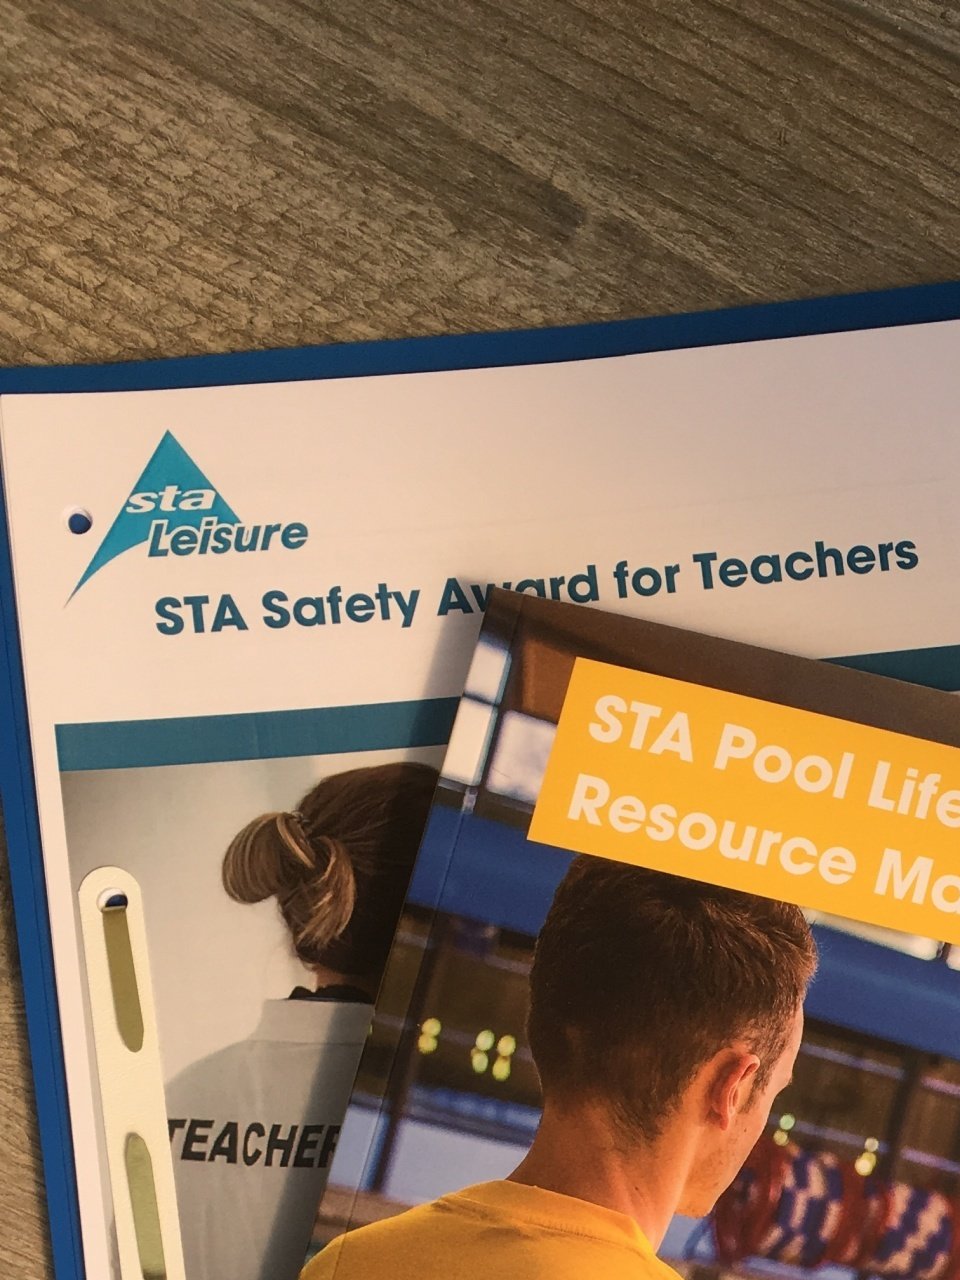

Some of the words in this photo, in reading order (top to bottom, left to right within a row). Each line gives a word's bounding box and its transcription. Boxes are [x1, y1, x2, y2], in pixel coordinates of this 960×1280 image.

[125, 485, 216, 514] sta
[147, 519, 309, 557] Leisure
[155, 593, 248, 635] STA
[262, 585, 420, 630] Safety
[613, 561, 680, 599] for
[693, 539, 919, 592] Teachers
[588, 694, 694, 763] STA
[713, 724, 855, 801] Pool
[566, 773, 858, 886] Resource
